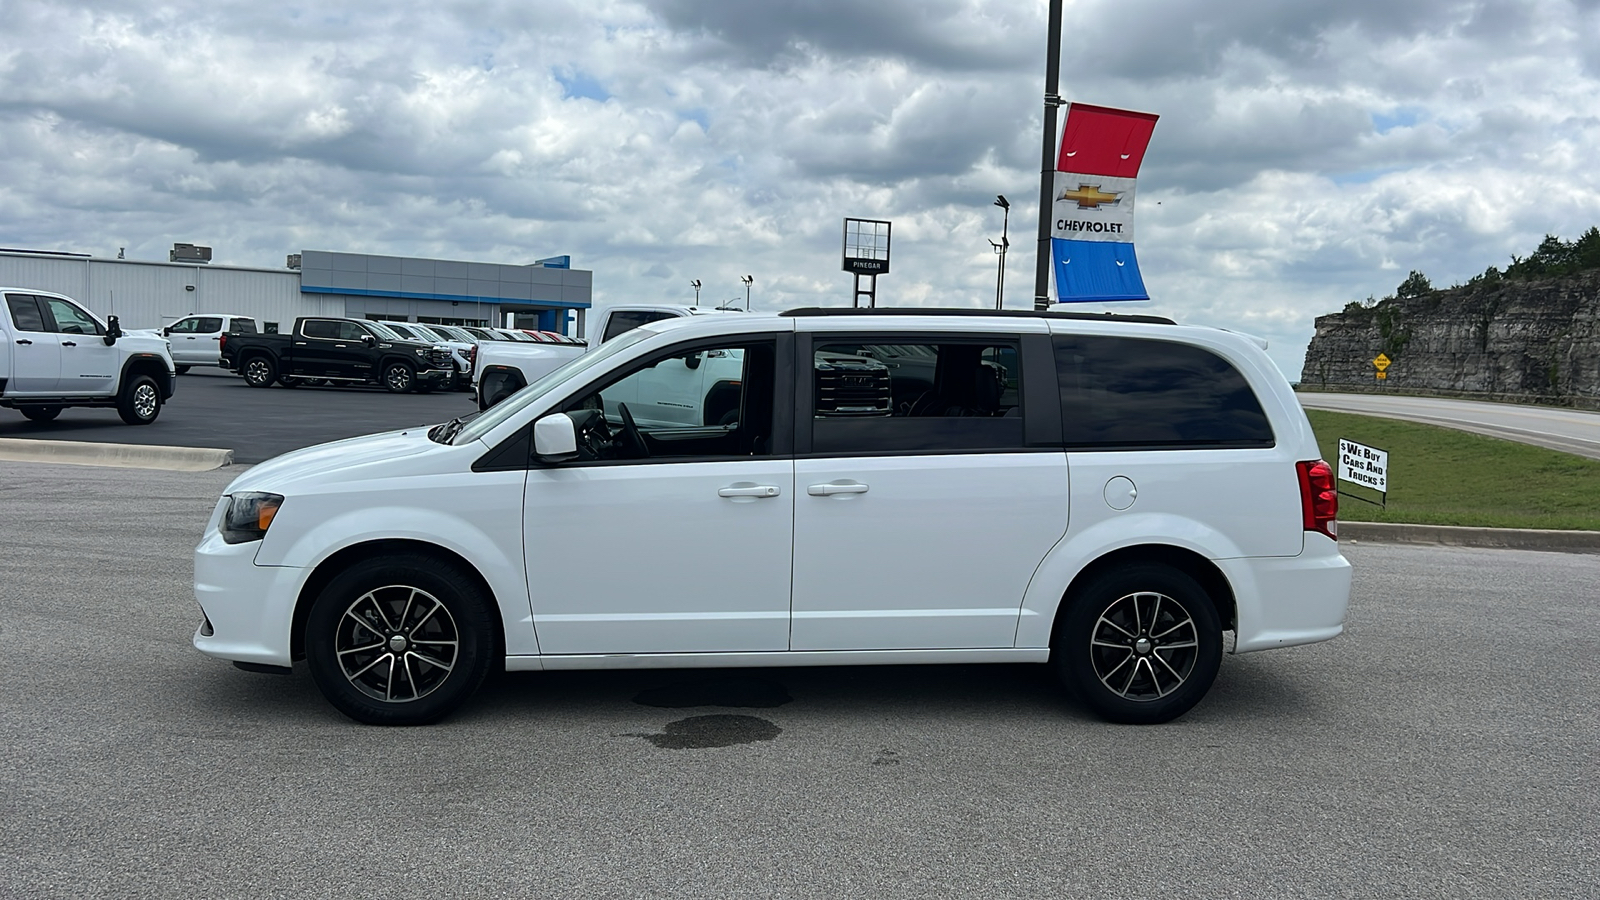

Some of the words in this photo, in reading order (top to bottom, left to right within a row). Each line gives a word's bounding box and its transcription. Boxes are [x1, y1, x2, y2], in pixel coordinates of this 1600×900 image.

[1056, 219, 1123, 233] CHEVROLET
[853, 261, 881, 270] PINEGAR
[1342, 454, 1365, 470] CARS
[1366, 461, 1383, 475] AND
[1347, 467, 1378, 486] TRUCKS
